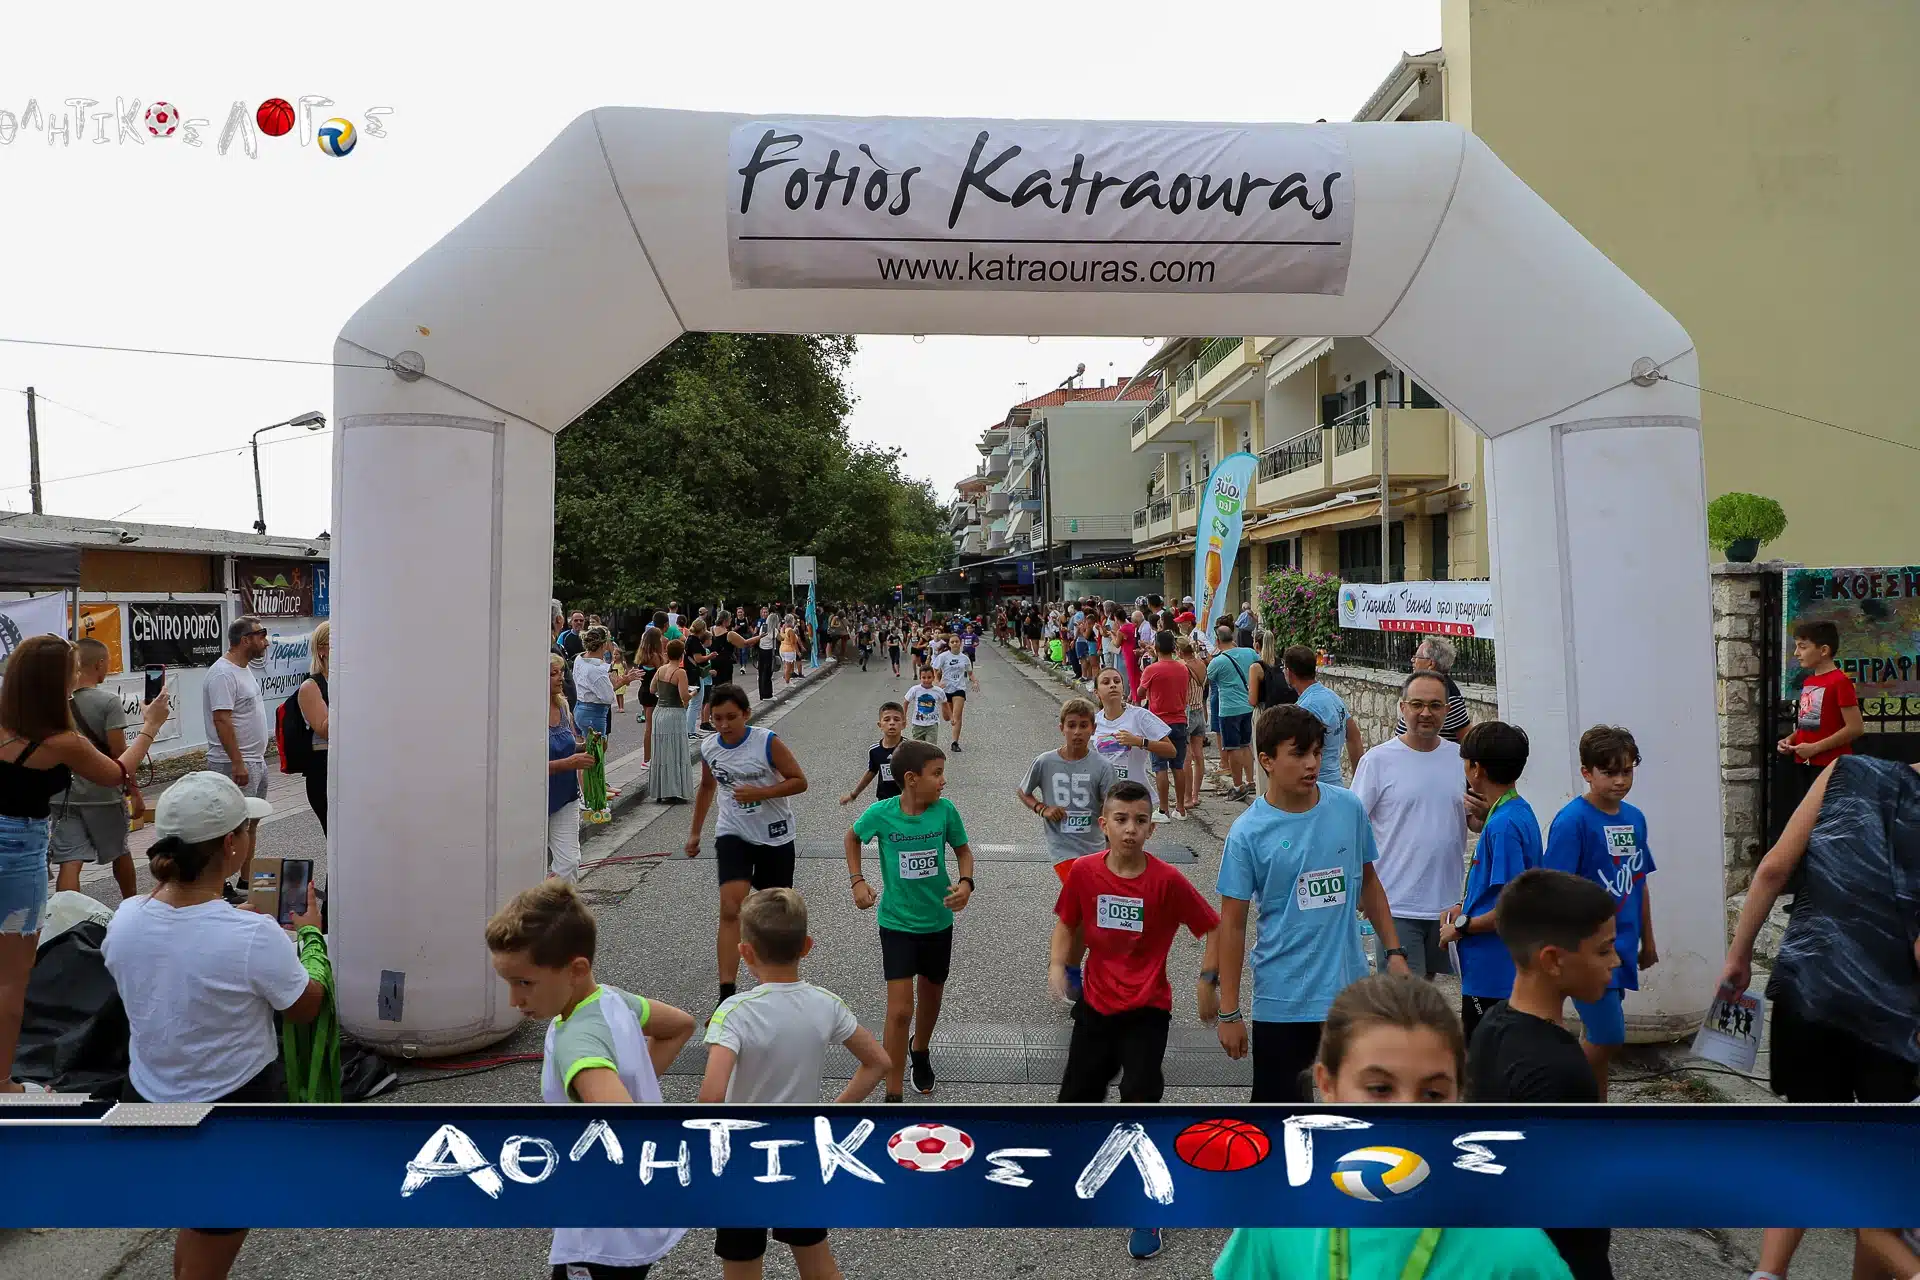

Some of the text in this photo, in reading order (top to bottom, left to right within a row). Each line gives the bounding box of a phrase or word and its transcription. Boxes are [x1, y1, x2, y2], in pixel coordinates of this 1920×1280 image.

[948, 130, 1342, 230] Katraouras
[876, 251, 1216, 284] www.katraouras.com
[132, 615, 220, 641] CENTRO PORTO
[1052, 773, 1090, 808] 65
[1070, 817, 1089, 826] 064
[1614, 834, 1634, 846] 134
[910, 857, 935, 870] 096
[1310, 878, 1341, 896] 010
[1110, 904, 1139, 920] 085
